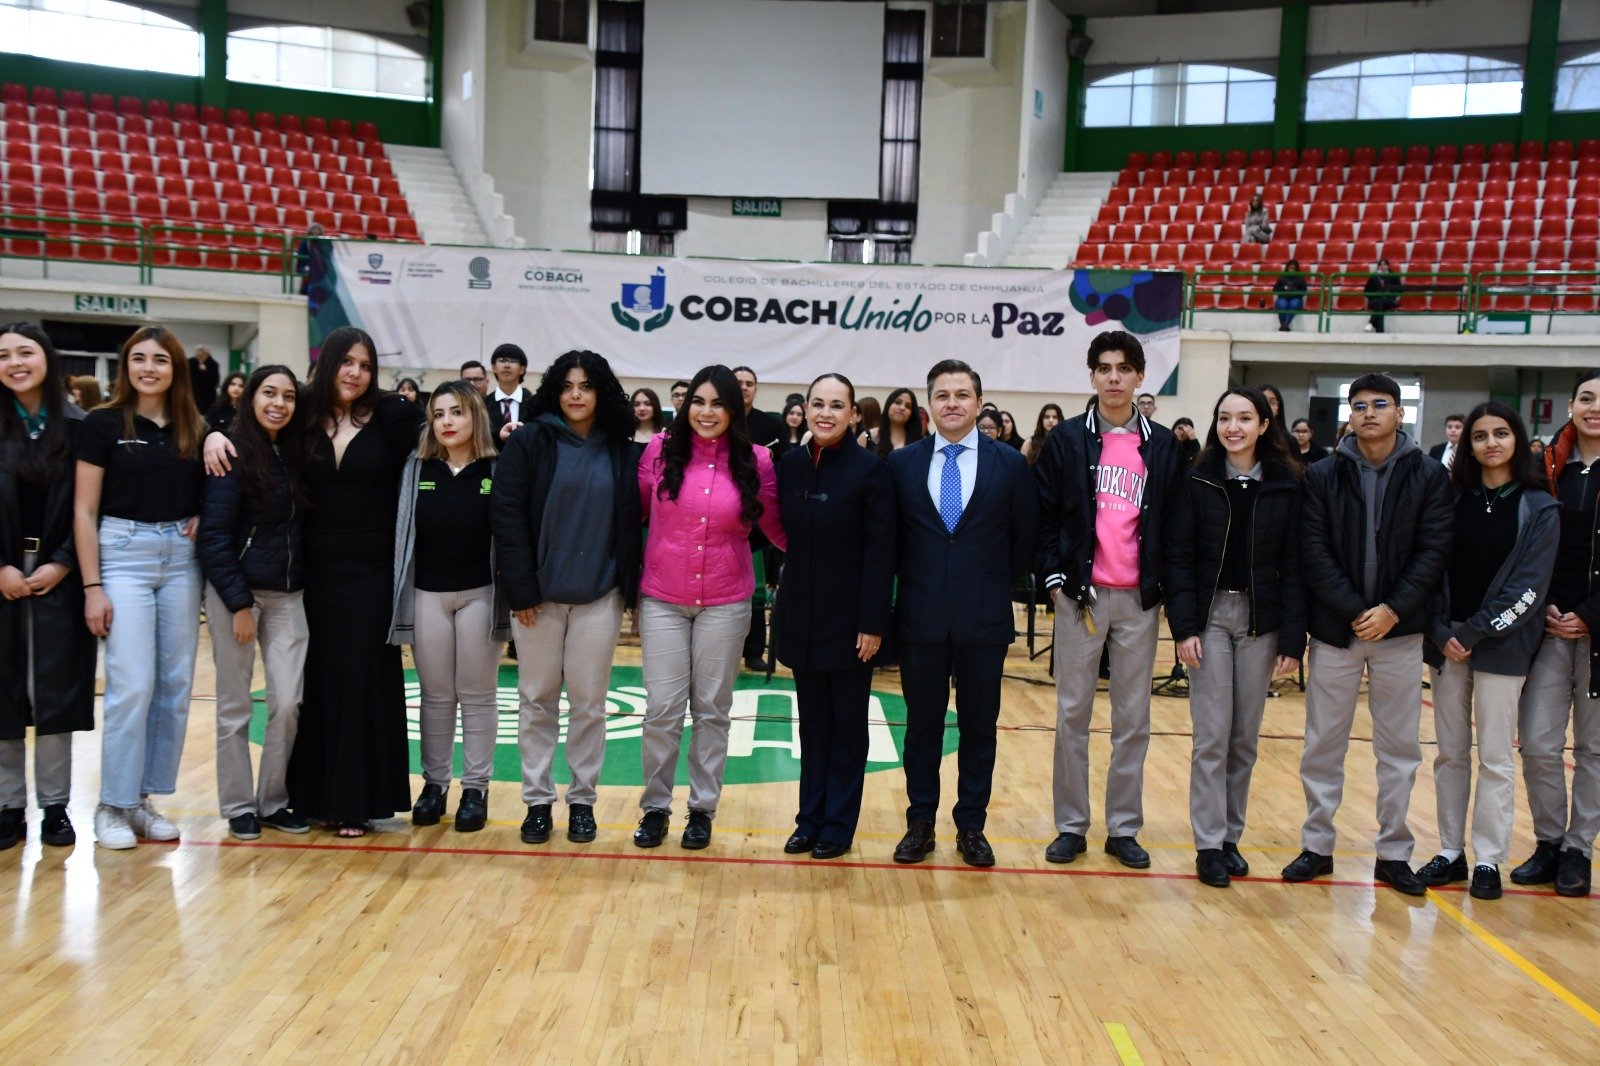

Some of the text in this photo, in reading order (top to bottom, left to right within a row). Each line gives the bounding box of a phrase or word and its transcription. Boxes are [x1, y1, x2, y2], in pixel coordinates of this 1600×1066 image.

[734, 200, 780, 213] SALIDA
[524, 270, 584, 283] COBACH
[704, 275, 1045, 294] COLEGIO DE BACHILLERES DEL ESTADO DE CHIHUAHUA
[79, 294, 143, 313] SALIDA
[680, 293, 1066, 339] COBACH Unido POR LA Paz
[1095, 465, 1148, 509] OOKLYN
[1096, 501, 1106, 509] EW
